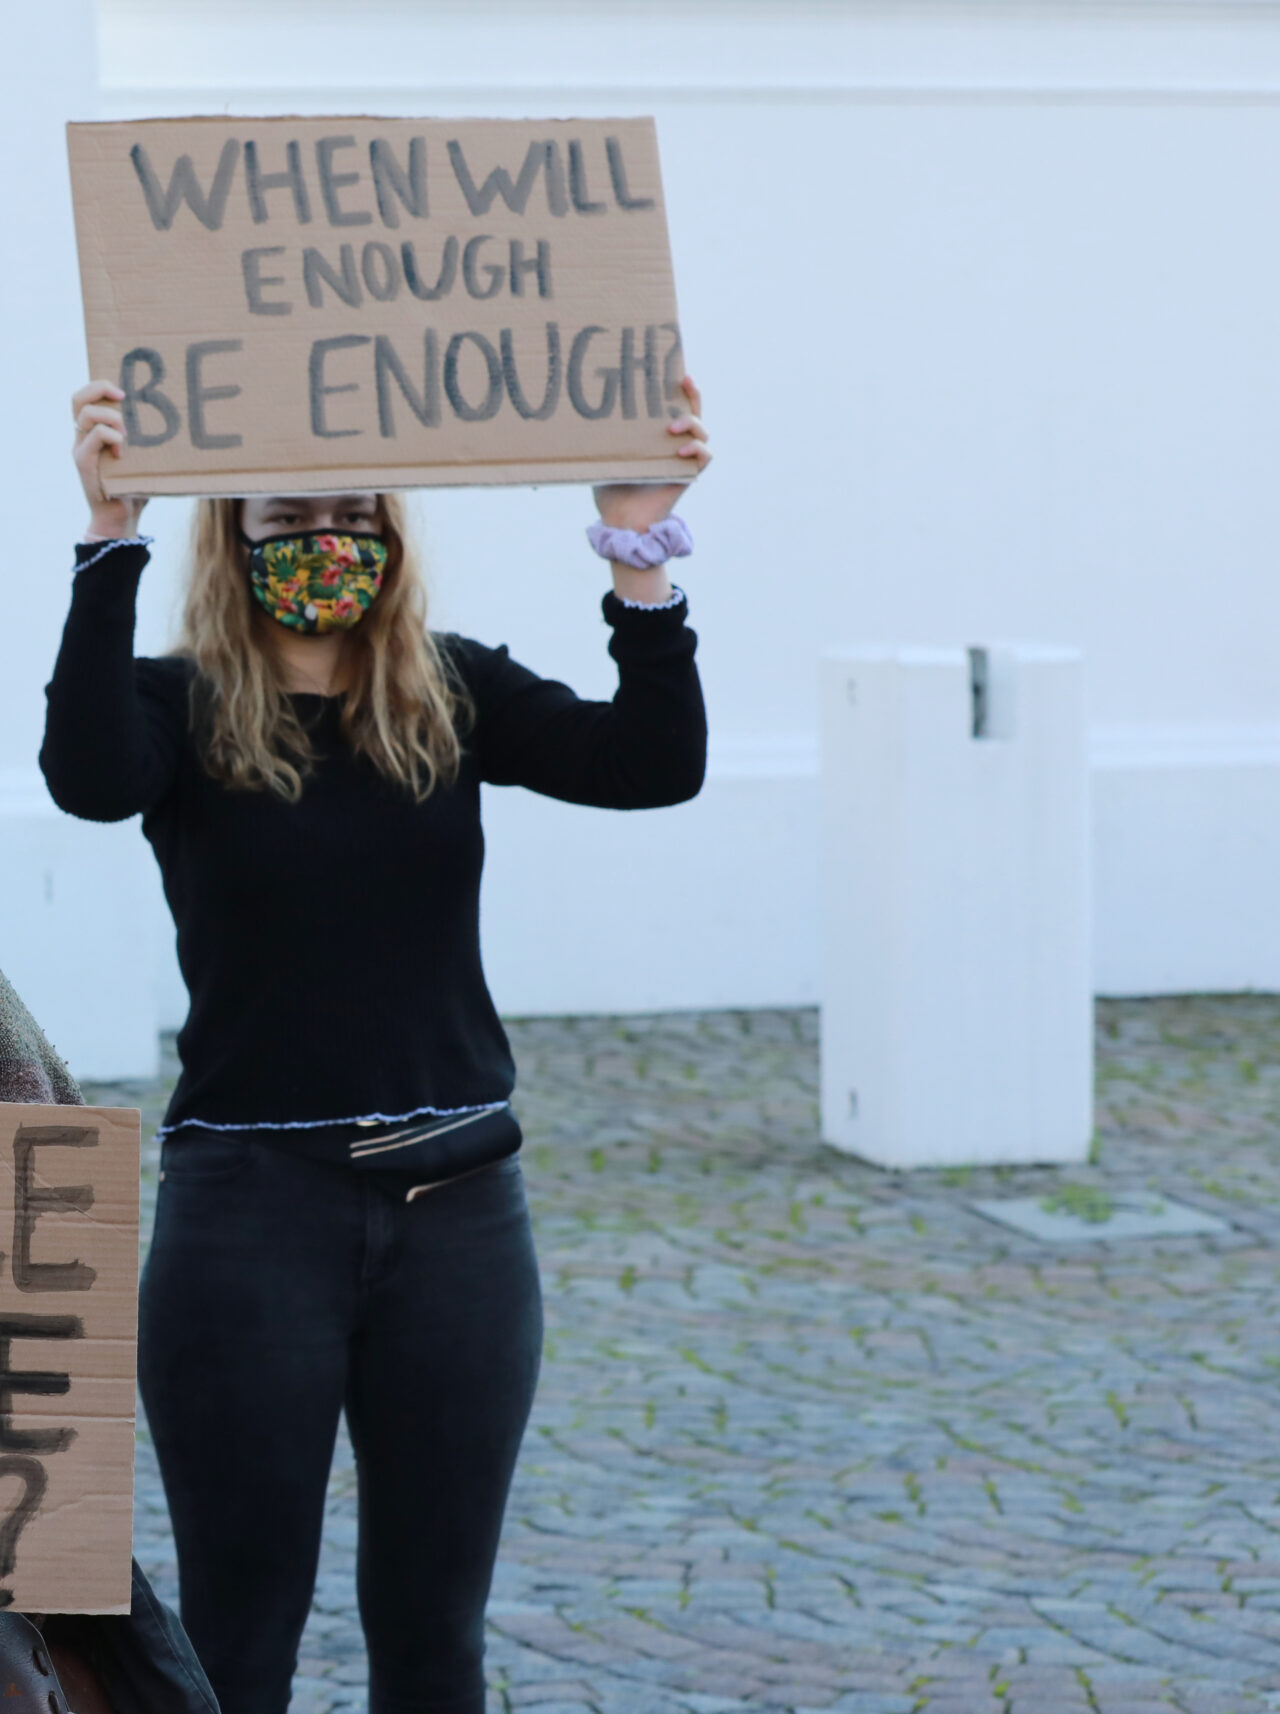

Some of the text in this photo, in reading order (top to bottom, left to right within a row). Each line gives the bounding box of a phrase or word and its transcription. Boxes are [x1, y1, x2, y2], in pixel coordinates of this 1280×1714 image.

[129, 136, 656, 231] WHEN WILL
[241, 234, 555, 316] ENOUGH
[121, 321, 682, 450] BE ENOUGH?
